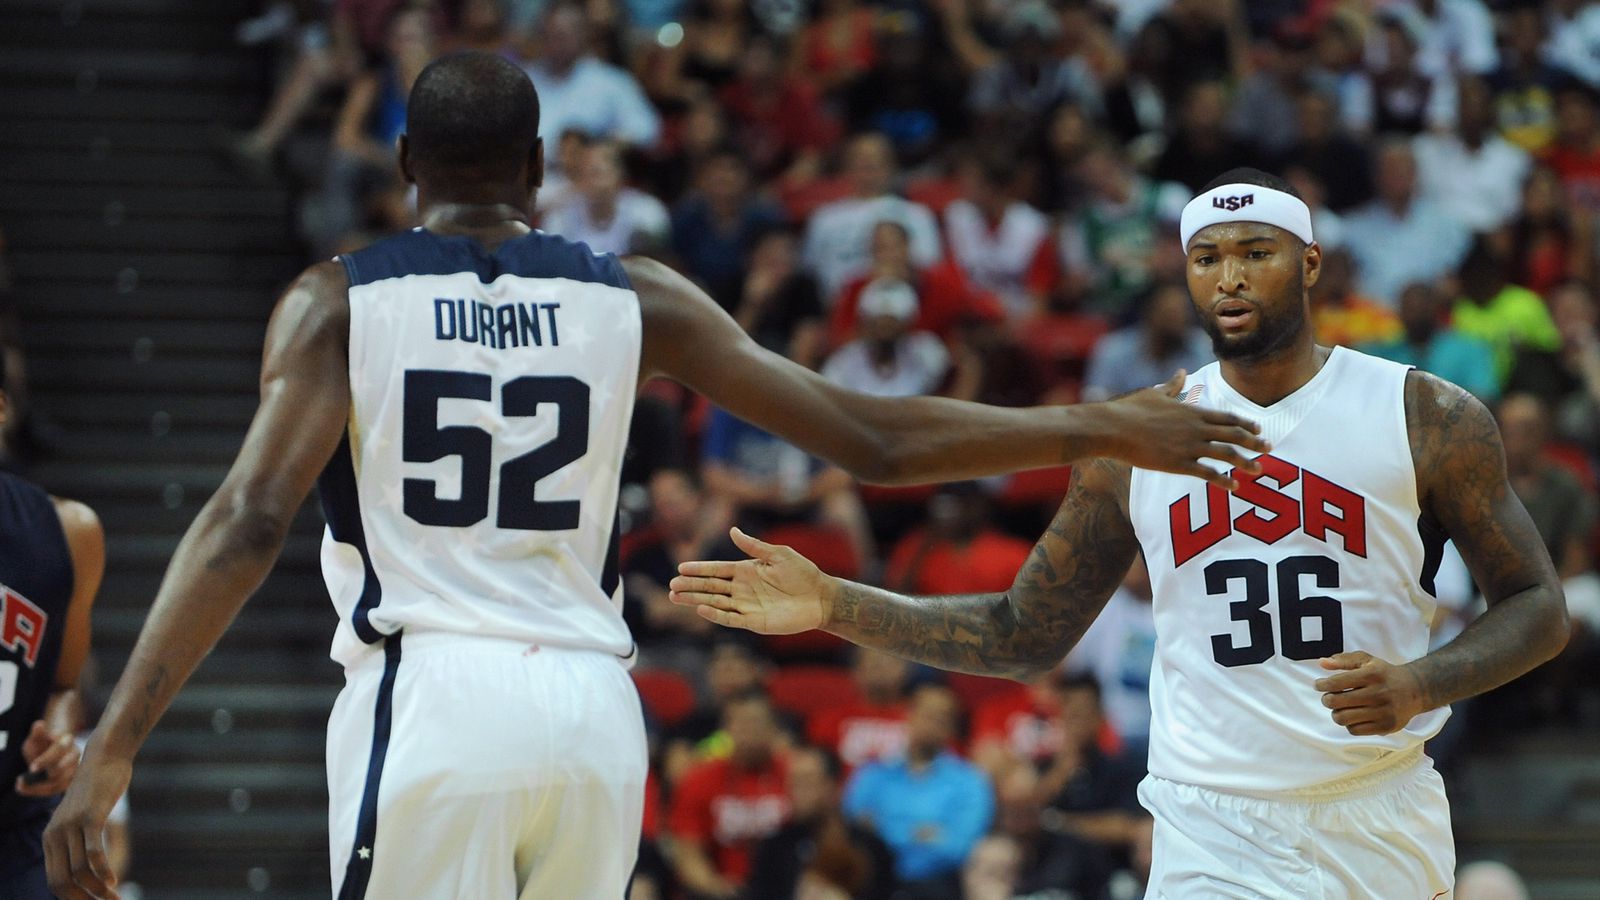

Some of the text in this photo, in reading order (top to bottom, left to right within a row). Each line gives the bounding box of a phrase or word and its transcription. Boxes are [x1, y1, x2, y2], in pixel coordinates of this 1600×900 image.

[1212, 193, 1254, 212] USA
[434, 298, 560, 349] DURANT
[403, 369, 590, 531] 52
[1169, 453, 1368, 569] USA
[1203, 555, 1344, 668] 36
